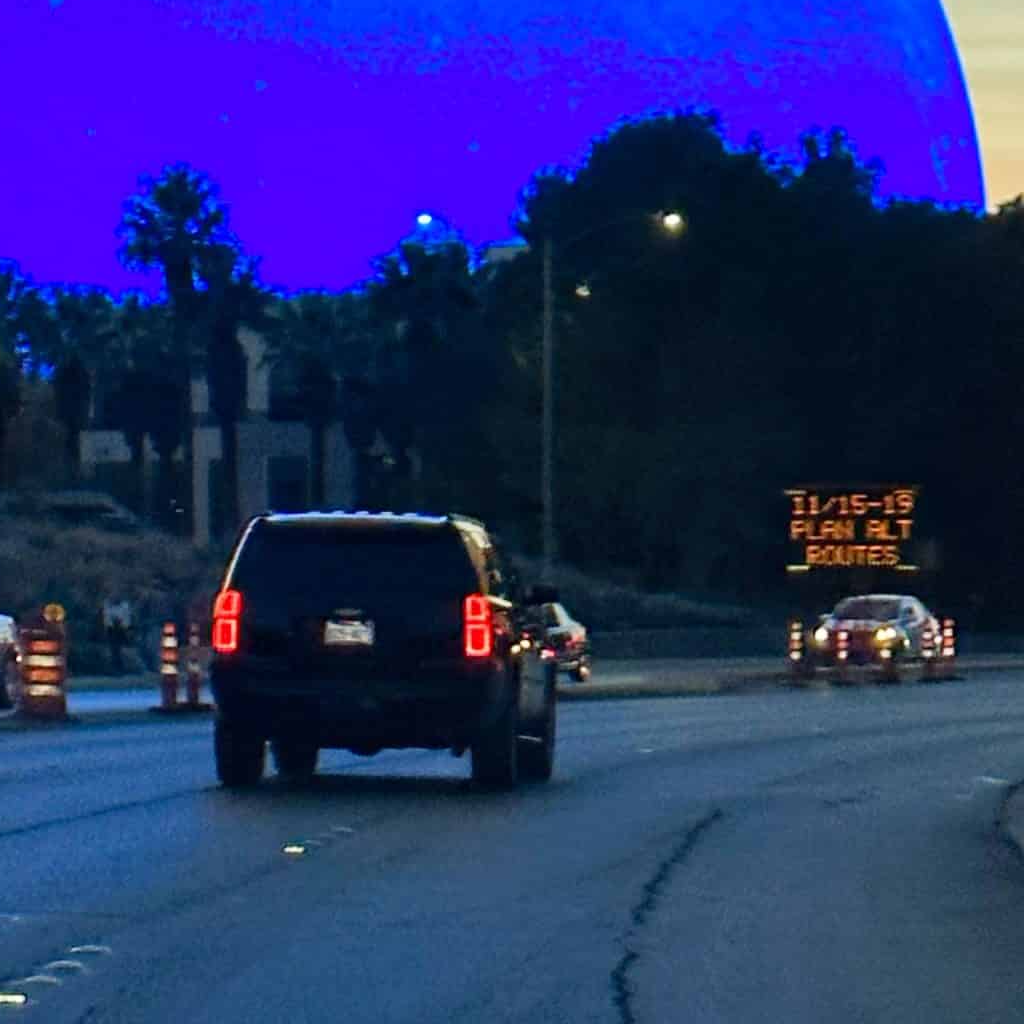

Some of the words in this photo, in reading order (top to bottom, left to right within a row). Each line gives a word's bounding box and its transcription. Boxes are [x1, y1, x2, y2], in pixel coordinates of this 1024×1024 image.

[790, 519, 855, 540] PLAN
[865, 519, 914, 540] ALT
[806, 545, 900, 565] ROUTES
